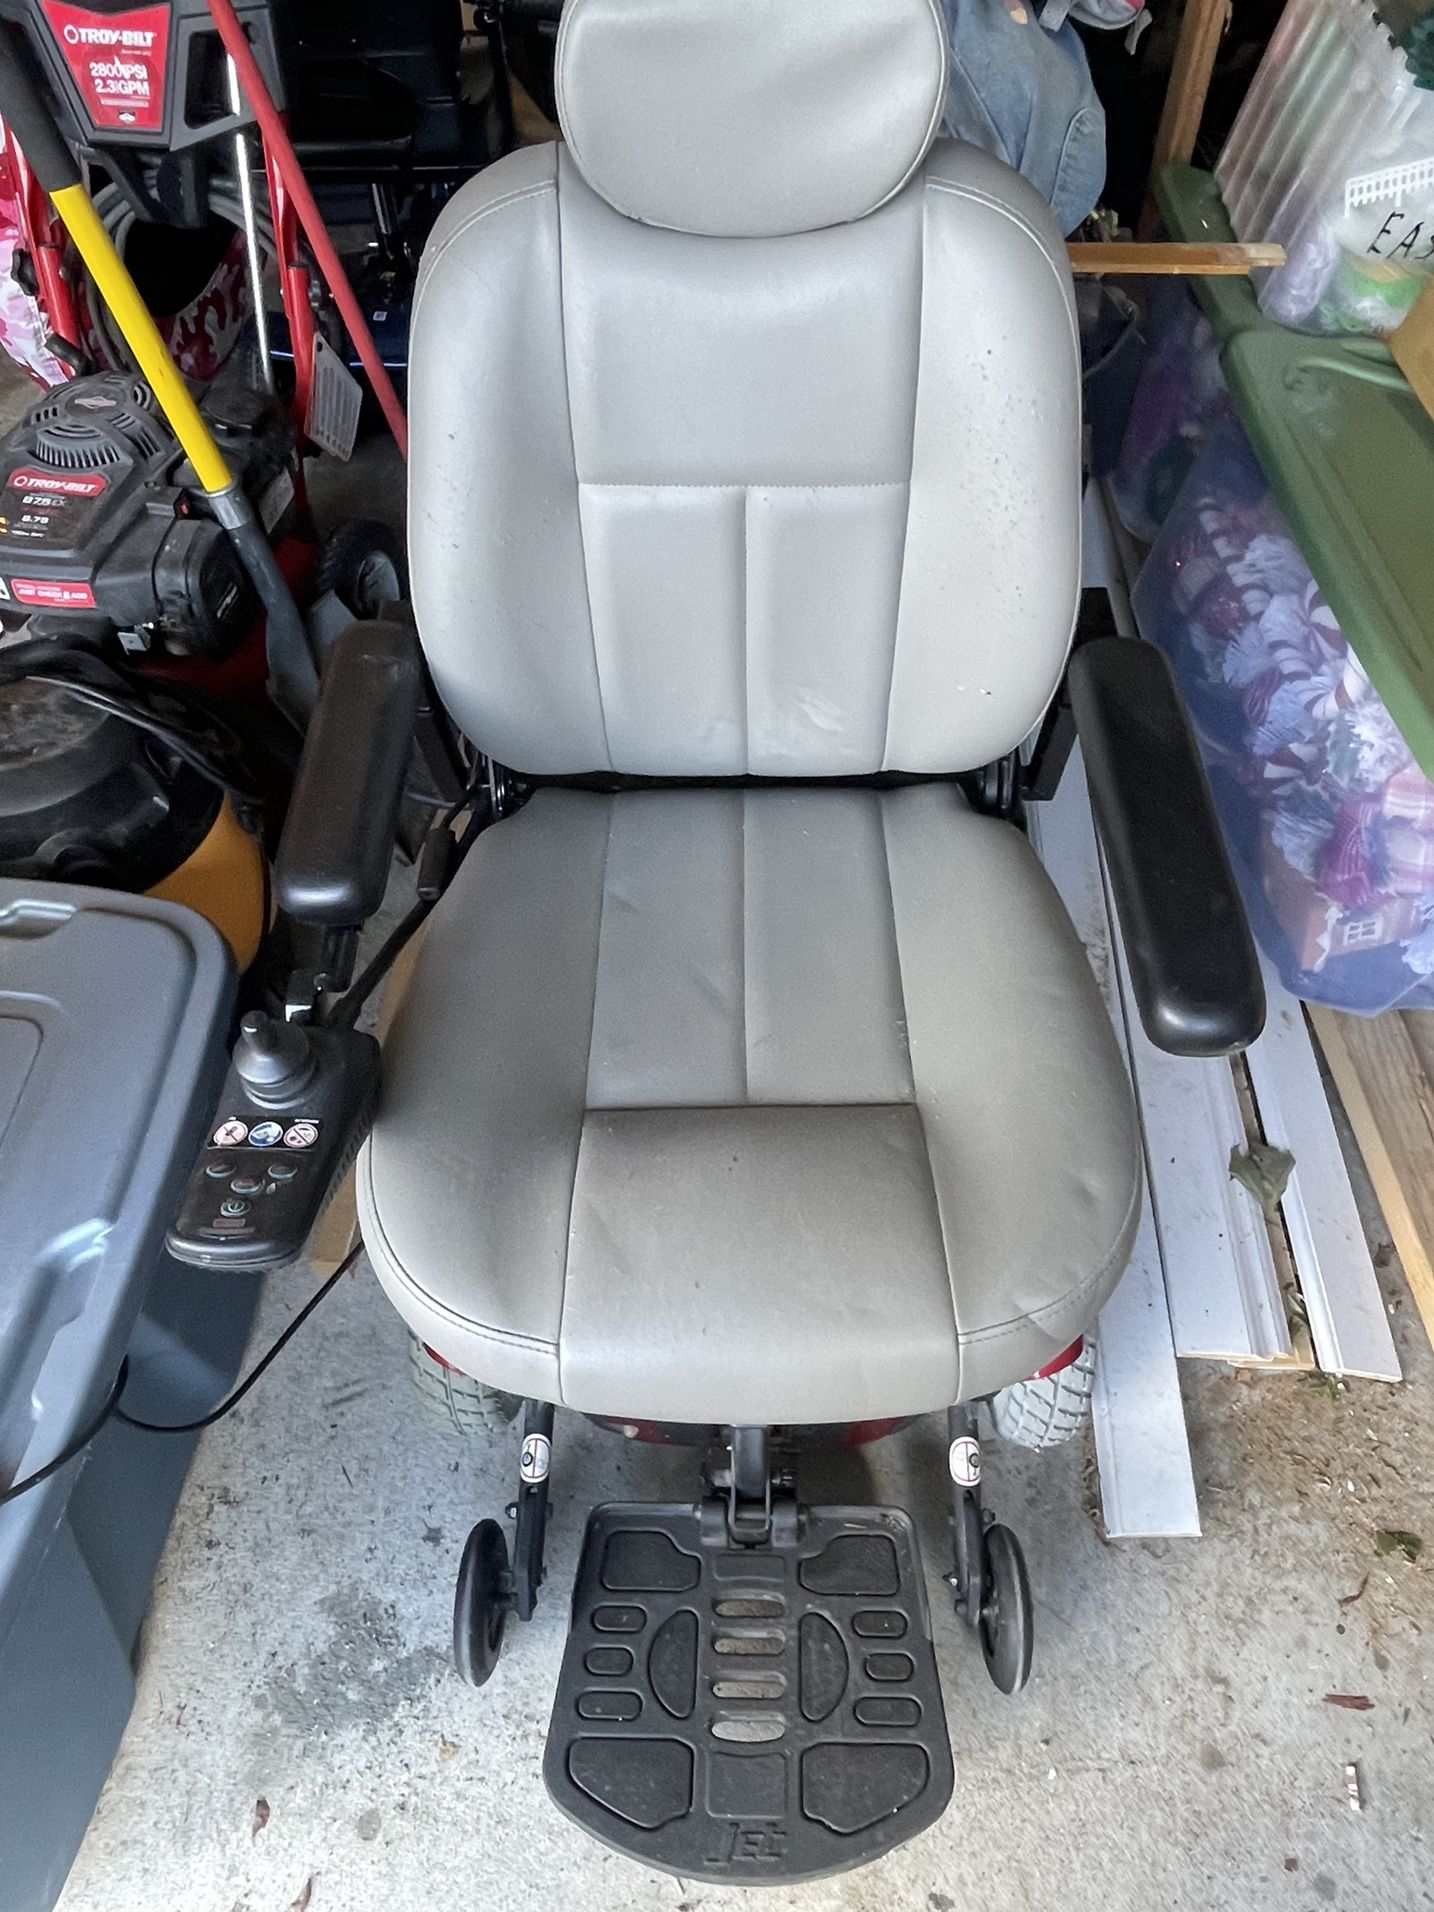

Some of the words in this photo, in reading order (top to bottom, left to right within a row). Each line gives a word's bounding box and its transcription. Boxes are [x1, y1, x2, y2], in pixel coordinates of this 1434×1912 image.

[78, 27, 155, 47] TROY-BILT
[89, 61, 121, 77] 2800
[127, 64, 148, 80] PSI
[94, 78, 115, 94] 2.3
[119, 80, 150, 96] GPM
[27, 478, 96, 493] TROY-BILT
